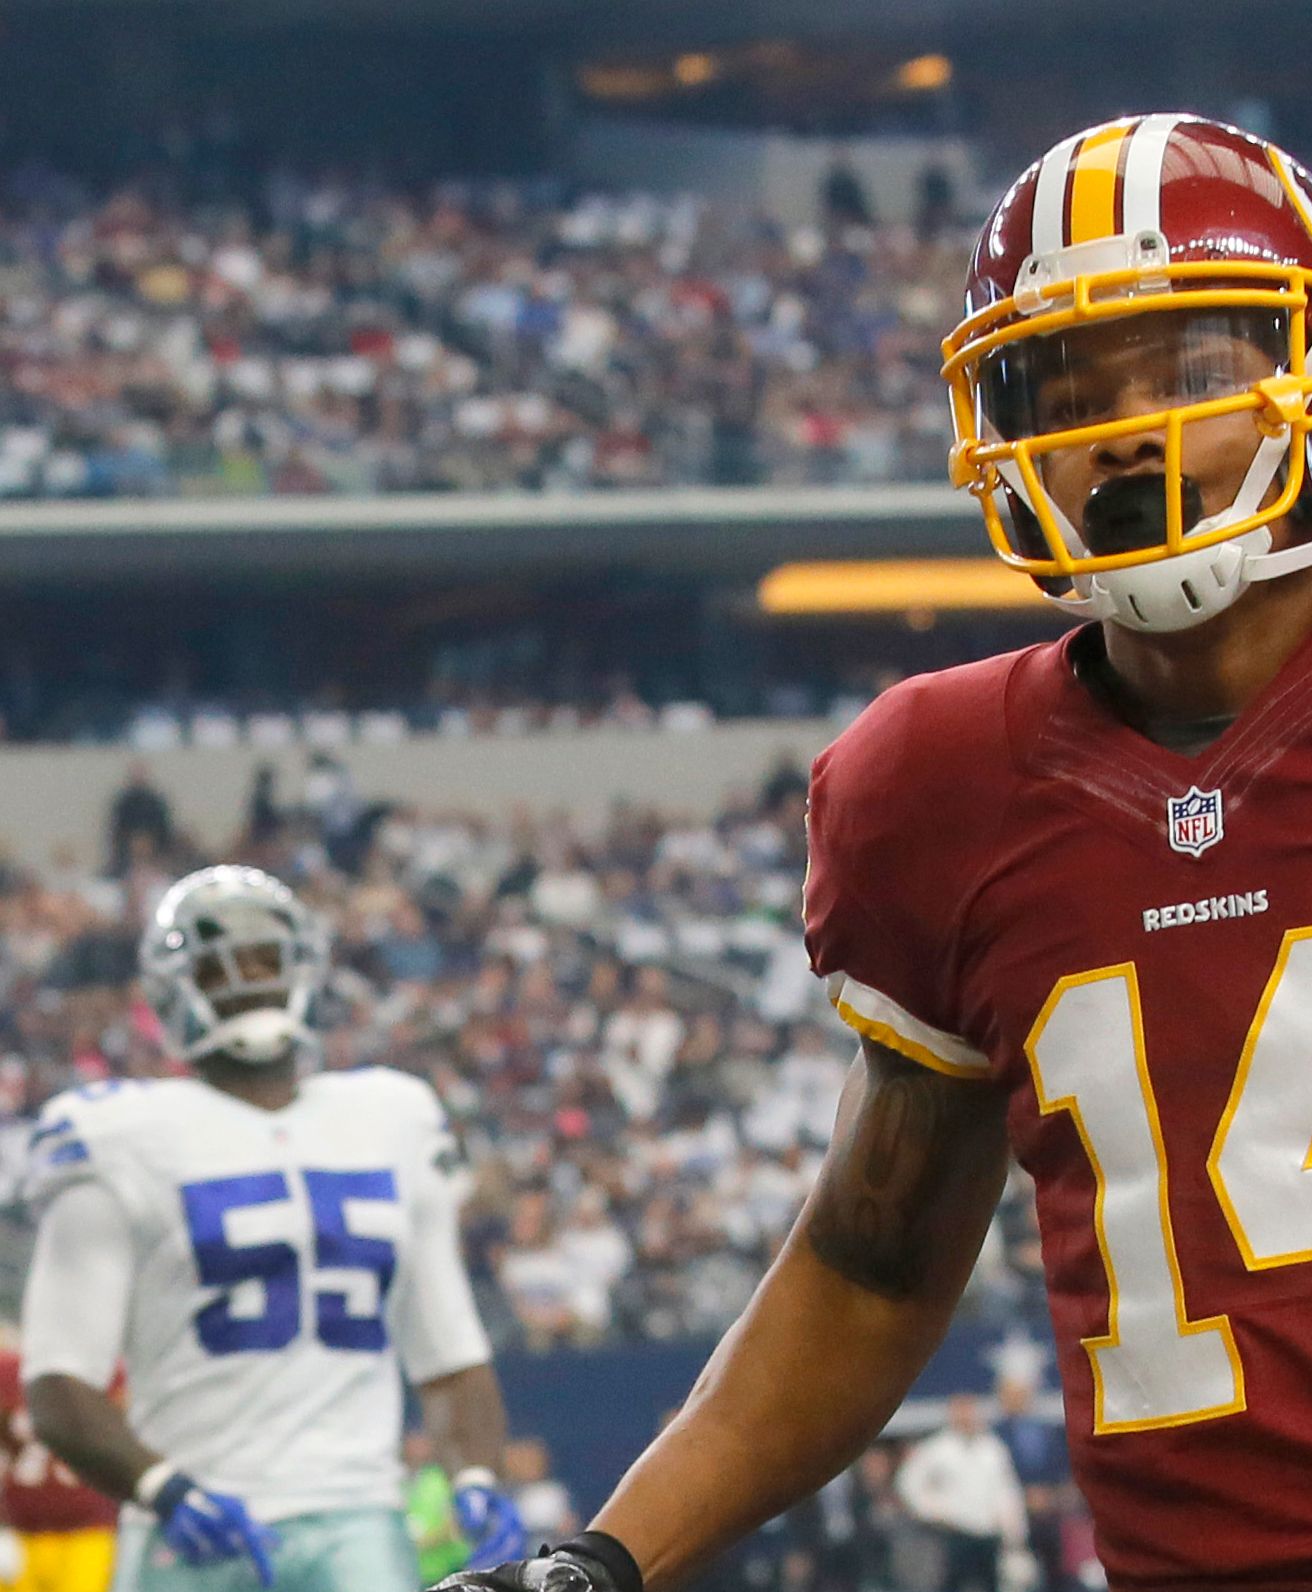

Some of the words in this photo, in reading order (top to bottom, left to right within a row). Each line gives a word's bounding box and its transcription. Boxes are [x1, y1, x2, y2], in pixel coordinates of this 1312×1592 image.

[1176, 816, 1215, 844] NFL
[1142, 889, 1269, 932] REDSKINS
[180, 1169, 398, 1356] 55
